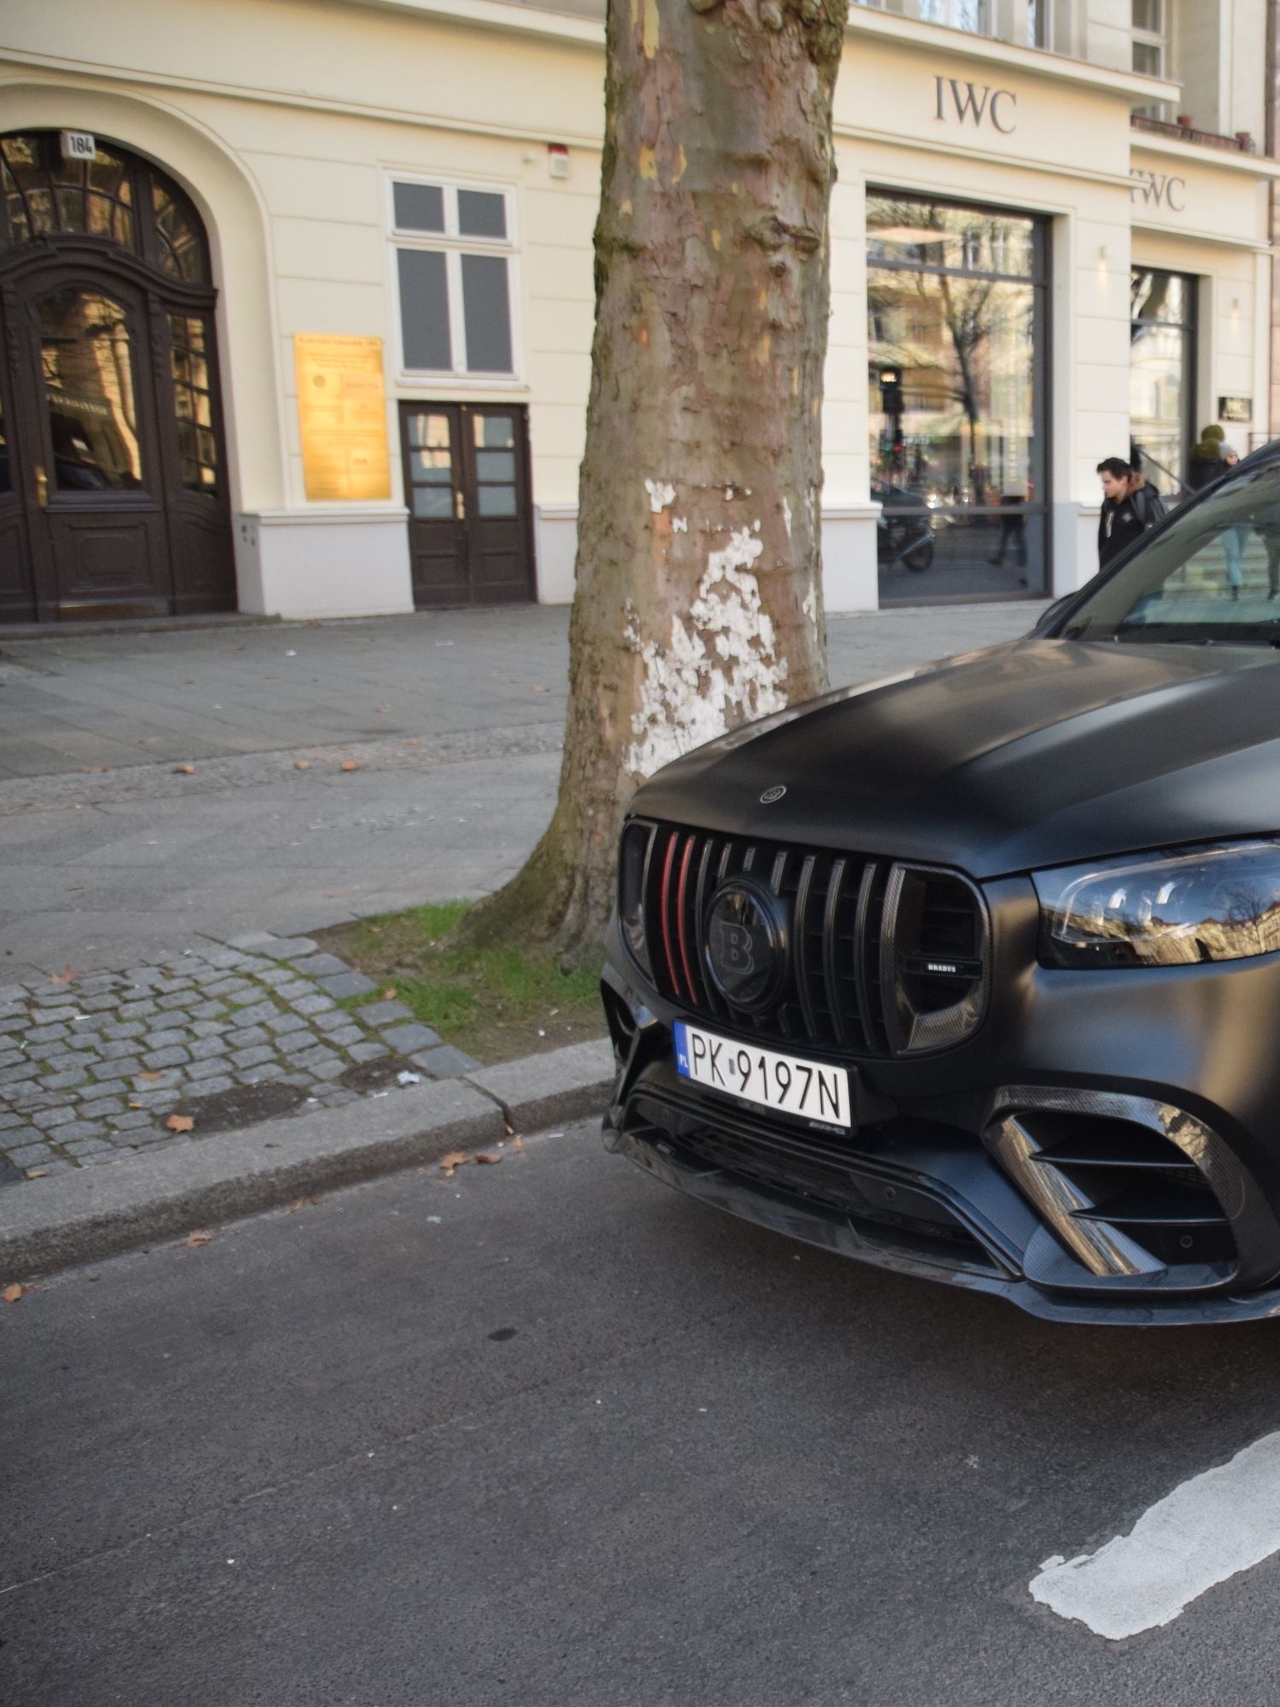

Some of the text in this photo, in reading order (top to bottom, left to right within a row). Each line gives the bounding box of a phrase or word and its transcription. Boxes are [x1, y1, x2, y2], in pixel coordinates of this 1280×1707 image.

[933, 75, 1017, 134] IWC
[70, 135, 93, 155] 184
[679, 1054, 689, 1069] PL
[692, 1033, 841, 1119] PK 9197N
